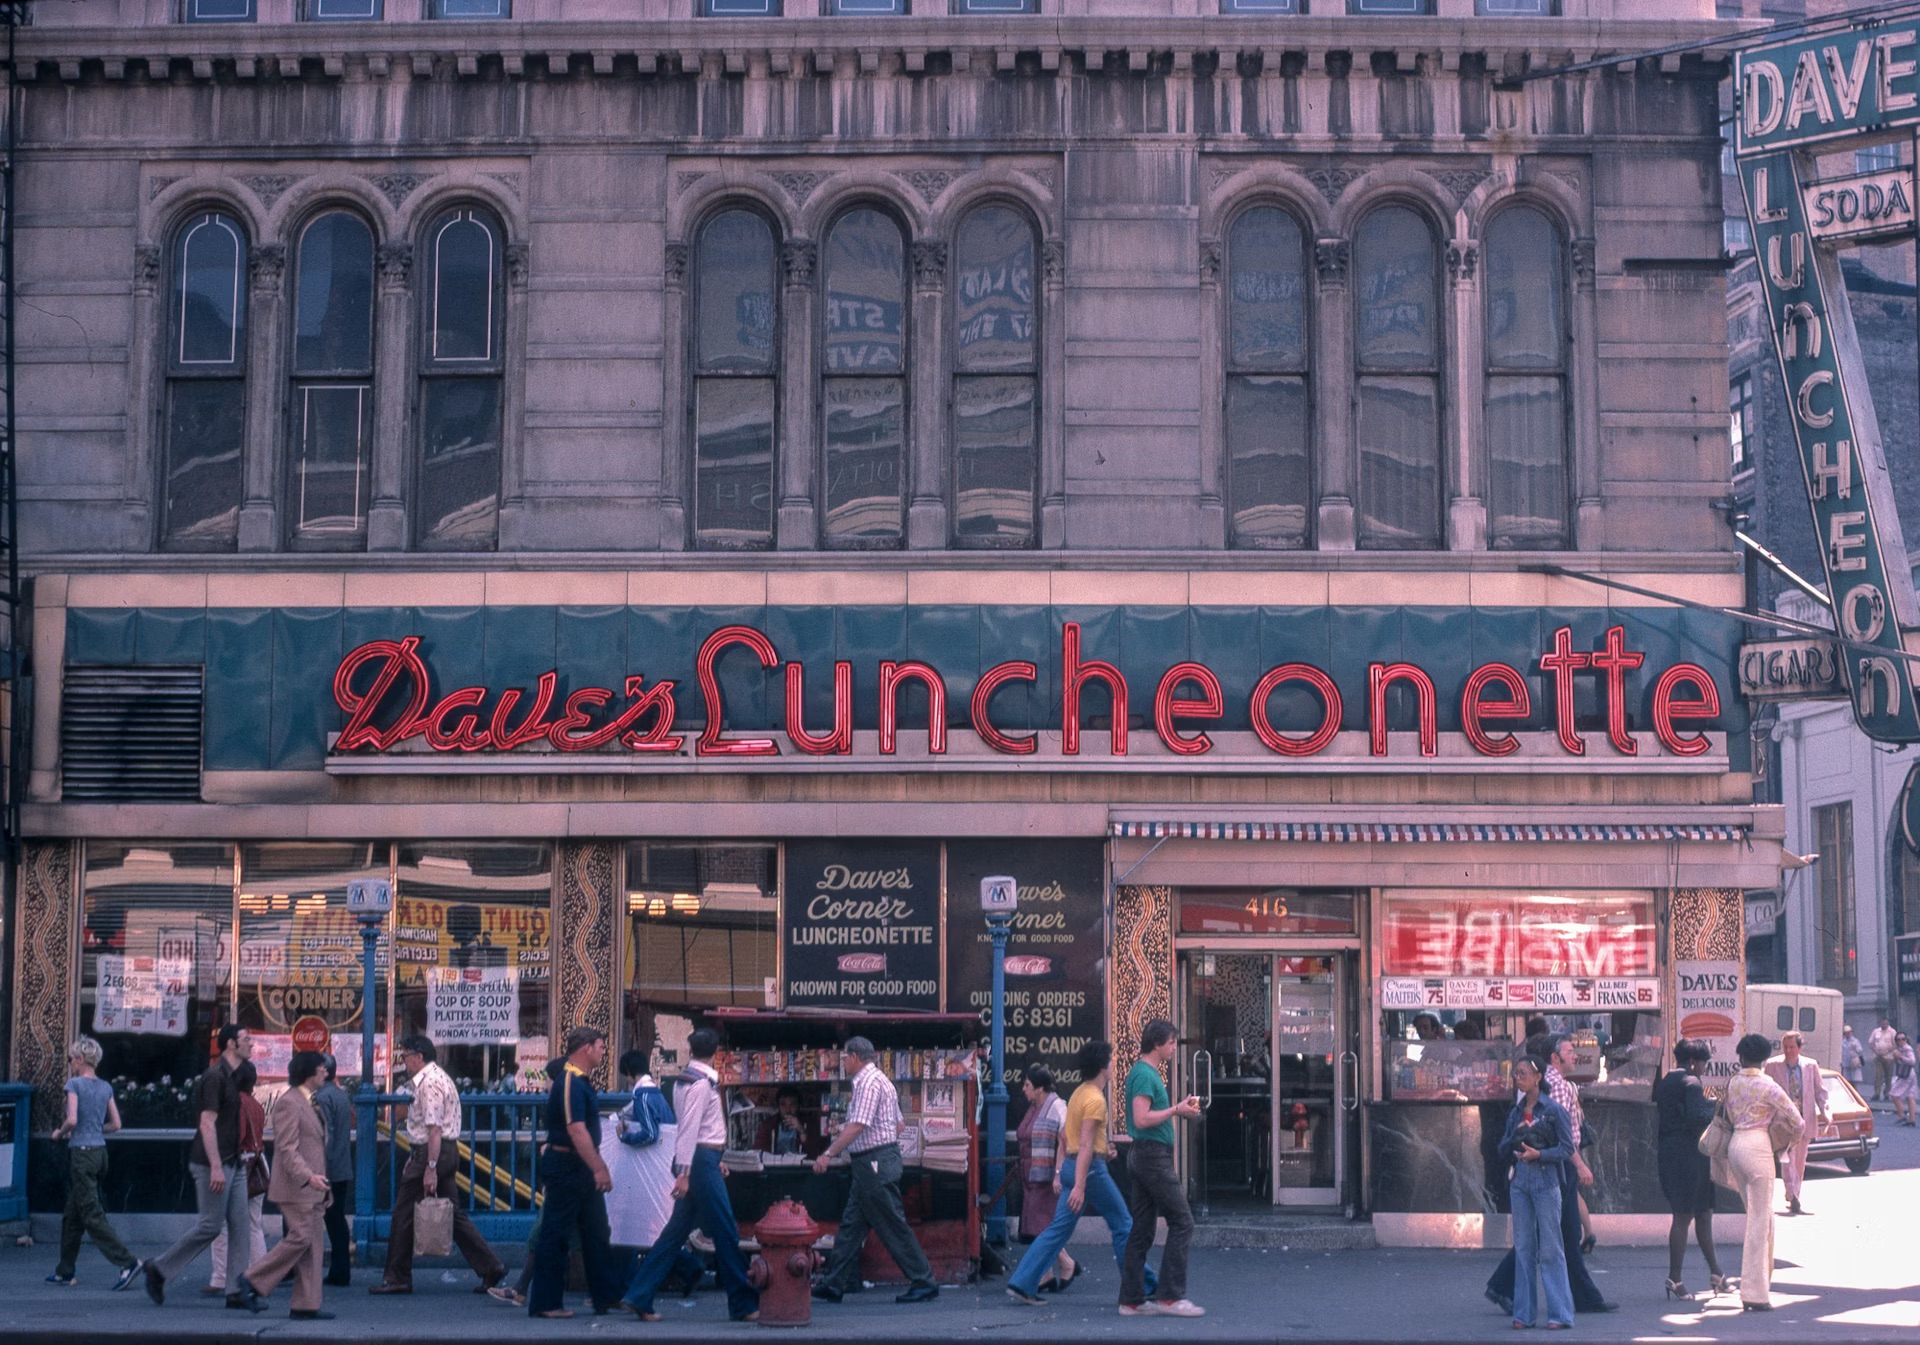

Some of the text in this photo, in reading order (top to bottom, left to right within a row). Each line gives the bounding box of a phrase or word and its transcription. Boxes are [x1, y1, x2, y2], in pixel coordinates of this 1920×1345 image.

[1813, 179, 1911, 227] SODA
[1743, 647, 1836, 688] CIGARS
[333, 621, 1721, 757] Dave's Luncheonette
[816, 864, 914, 890] Dave's
[1017, 880, 1066, 901] ave's
[806, 894, 914, 920] Corner
[1245, 897, 1289, 918] 416
[792, 926, 933, 945] LUNCHEONETTE
[1011, 933, 1027, 943] FOR
[1030, 933, 1052, 943] GOOD
[1053, 933, 1075, 943] FOOD
[790, 979, 937, 996] KNOWN FOR GOOD FOOD
[1538, 981, 1561, 992] DIET
[1598, 981, 1612, 989] ALL
[1613, 981, 1629, 989] BEEF
[269, 989, 355, 1009] CORNER
[970, 991, 1086, 1007] OUTOING ORDERS
[1385, 991, 1422, 1004] MALTEDS
[1427, 990, 1444, 1004] 75
[1487, 986, 1503, 1001] 45
[1538, 993, 1567, 1005] SODA
[1577, 988, 1592, 1001] 35
[1598, 991, 1637, 1005] FRANKS
[435, 996, 512, 1008] CUP OF SOUP
[1682, 998, 1736, 1010] DELICIOUS
[435, 1010, 473, 1021] PLATTER
[490, 1010, 512, 1021] DAY
[435, 1029, 469, 1038] MONDAY
[479, 1029, 511, 1038] FRIDAY
[1704, 1061, 1741, 1077] ANKS
